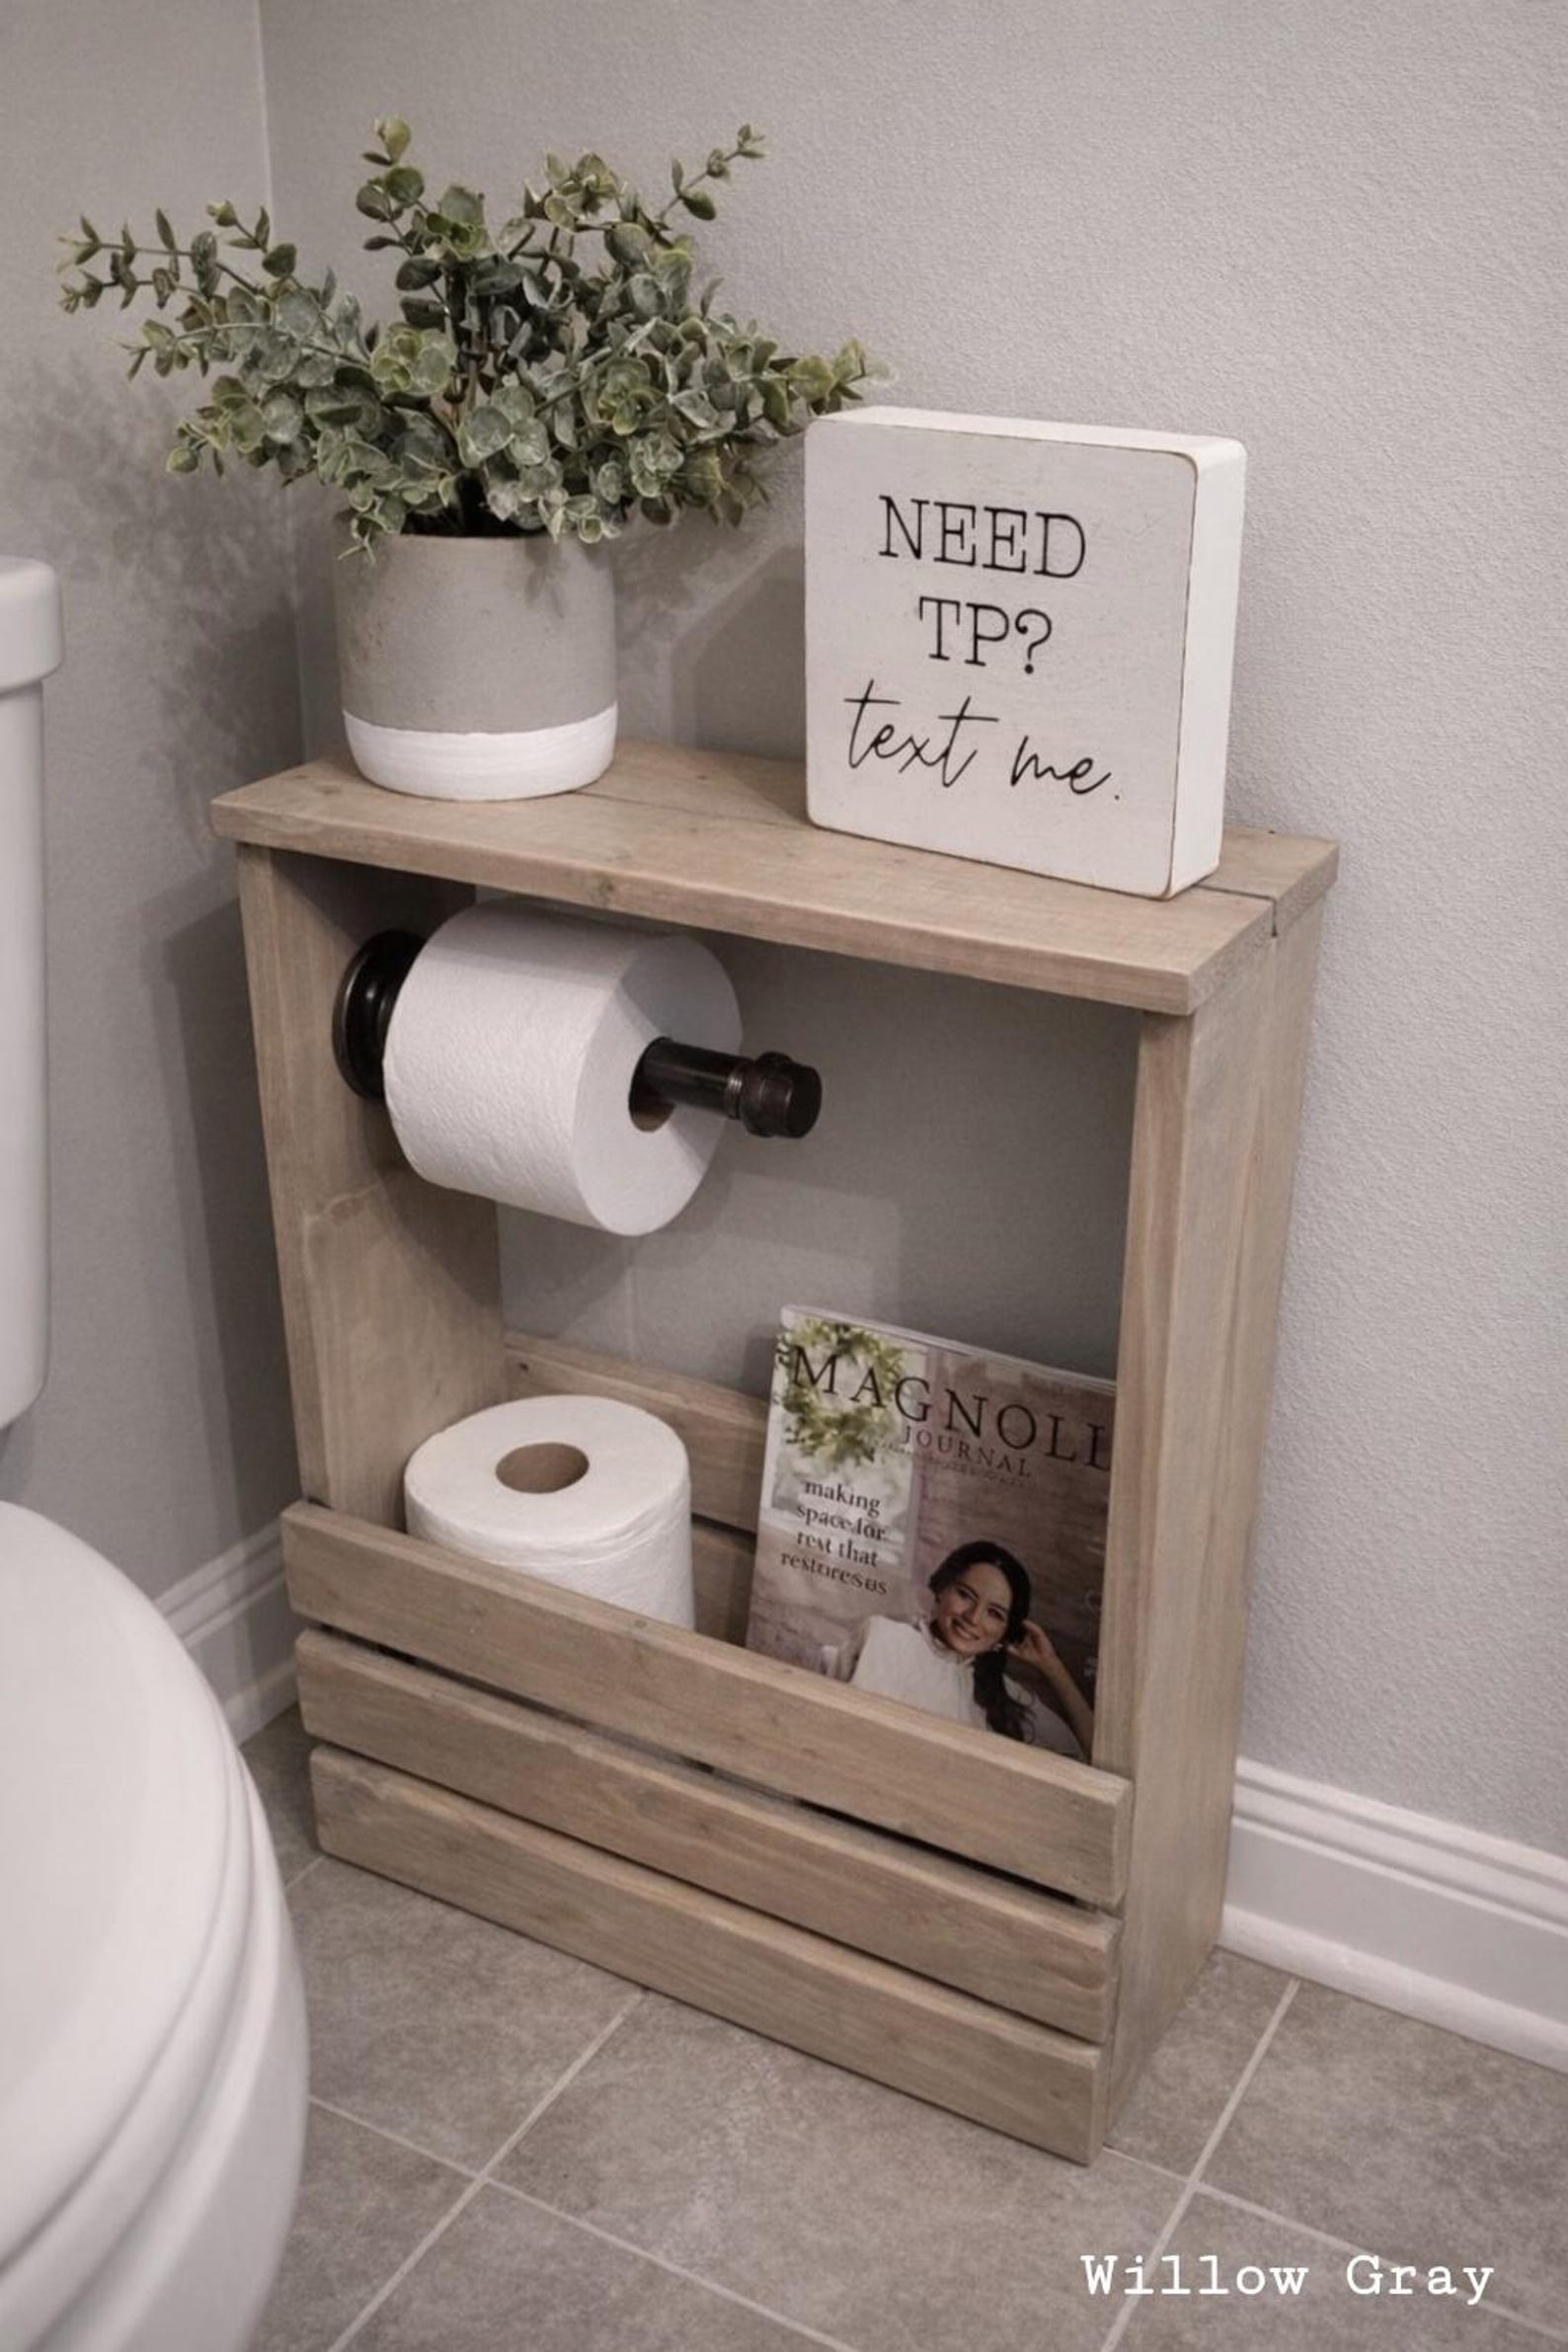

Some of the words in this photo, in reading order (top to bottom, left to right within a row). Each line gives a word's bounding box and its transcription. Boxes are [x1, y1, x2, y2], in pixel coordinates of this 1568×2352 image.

[878, 495, 1086, 579] NEED
[919, 595, 1053, 674] TP?
[844, 678, 999, 788] text
[1010, 735, 1121, 801] me.
[792, 1345, 1112, 1472] MAGNOLI
[902, 1425, 1032, 1477] JOURNAL
[796, 1504, 851, 1529] space
[856, 1518, 886, 1540] for
[803, 1480, 881, 1518] making
[797, 1531, 831, 1553] rest
[838, 1538, 878, 1568] that
